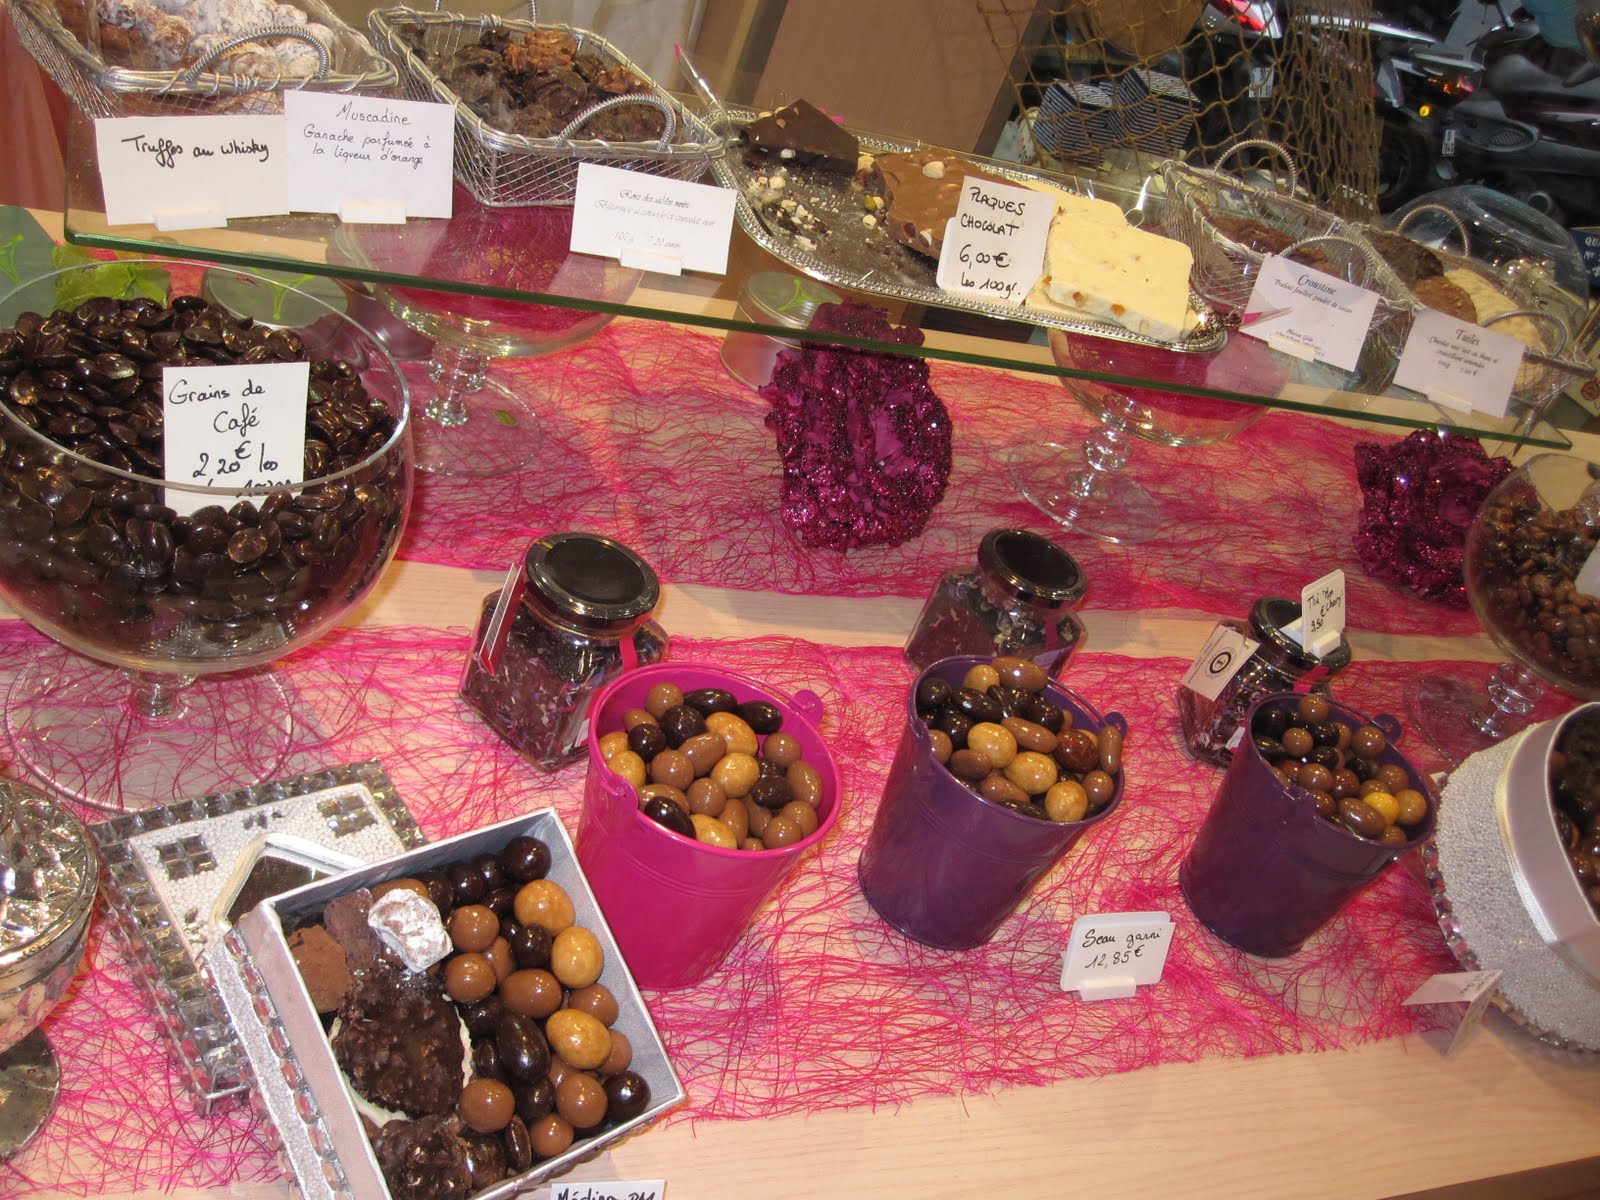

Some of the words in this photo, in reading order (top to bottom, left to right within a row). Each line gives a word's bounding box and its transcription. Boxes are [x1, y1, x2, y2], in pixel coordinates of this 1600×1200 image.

[336, 101, 412, 126] Muscadine
[304, 123, 354, 143] Ganache
[362, 131, 414, 151] parfumée
[424, 135, 431, 149] à
[120, 134, 184, 169] Truffes
[193, 147, 215, 158] au
[312, 143, 325, 155] la
[334, 145, 371, 163] liqueur
[380, 148, 424, 170] d'orange
[969, 187, 1026, 216] PLAQUES
[960, 213, 1020, 237] CHOCOLAT
[960, 244, 1010, 270] 6,00€
[1297, 273, 1337, 295] Croustine
[168, 379, 231, 405] Grains
[242, 379, 266, 397] de
[213, 403, 261, 437] Café
[1082, 928, 1116, 949] Seau
[1125, 927, 1163, 949] garni
[1084, 944, 1145, 970] 12,85€
